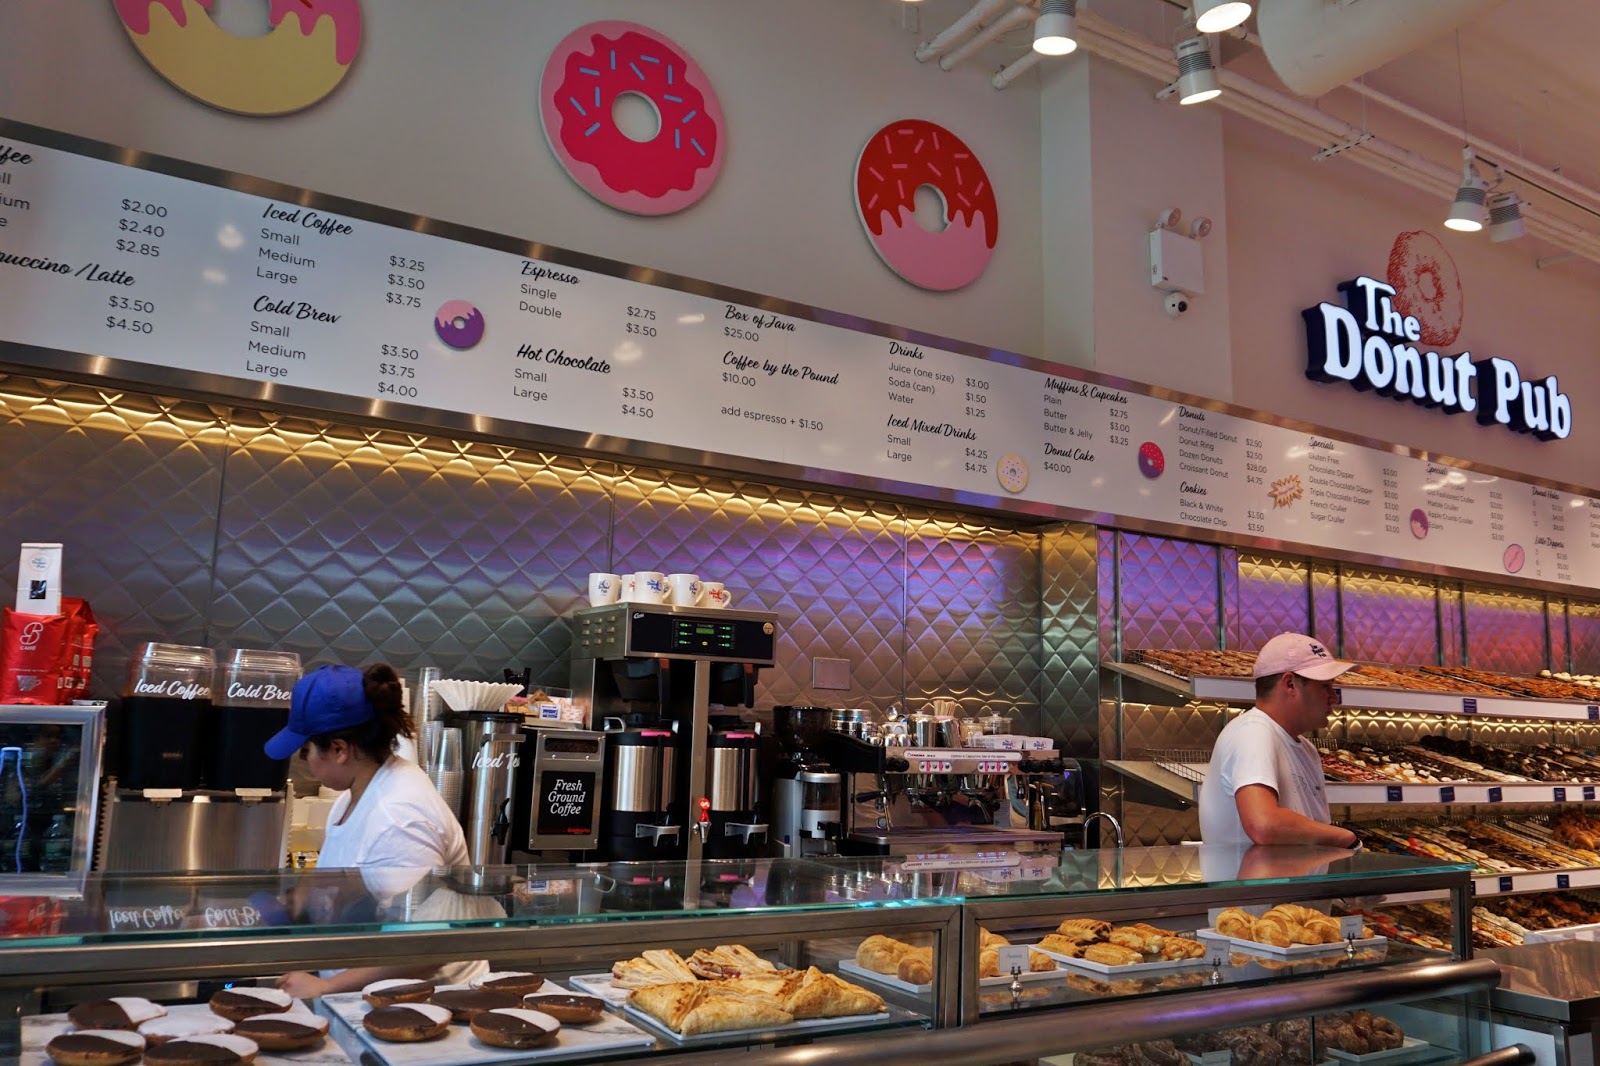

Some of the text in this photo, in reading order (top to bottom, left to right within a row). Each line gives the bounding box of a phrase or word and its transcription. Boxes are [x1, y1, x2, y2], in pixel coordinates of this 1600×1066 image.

[121, 198, 168, 218] $2.00
[118, 218, 165, 238] $2.40
[263, 203, 353, 236] Iced Coffee
[261, 228, 299, 245] Small
[116, 238, 160, 258] $2.85
[258, 247, 315, 268] Medium
[389, 255, 424, 272] $3.25
[521, 260, 580, 284] Espresso
[256, 267, 298, 284] Large
[388, 274, 424, 290] $3.50
[386, 292, 421, 308] $3.75
[521, 284, 557, 300] Single
[108, 295, 154, 314] $3.50
[254, 296, 341, 324] Cold Brew
[519, 301, 562, 318] Double
[627, 306, 656, 320] $2.75
[1356, 276, 1420, 341] The
[106, 316, 153, 334] $4.50
[725, 305, 796, 332] Box of Java
[250, 321, 290, 337] Small
[626, 323, 656, 337] $3.50
[724, 327, 759, 342] $25.00
[248, 341, 306, 360] Medium
[381, 344, 418, 360] $3.50
[517, 344, 611, 373] Hot Chocolate
[889, 342, 925, 360] Drinks
[246, 361, 288, 377] Large
[379, 363, 415, 378] $3.75
[514, 369, 547, 382] Small
[723, 351, 839, 385] Coffee by the Pound
[888, 363, 989, 390] Juice (one size) $3.00
[1320, 302, 1571, 438] Donut Pub
[722, 372, 756, 387] $10.00
[378, 382, 417, 398] $4.00
[513, 386, 548, 401] Large
[623, 388, 653, 401] $3.50
[888, 377, 986, 404] Soda (can) $1.50
[1044, 378, 1128, 405] Muffins & Cupcakes
[622, 404, 653, 418] $4.50
[888, 392, 986, 418] Water $1.25
[1044, 395, 1128, 420] Plain $2.75
[1179, 406, 1206, 422] Donuts
[721, 405, 741, 418] add
[743, 410, 787, 426] espresso
[798, 418, 823, 431] $1.50
[888, 414, 977, 441] Iced Mixed Drinks
[1044, 409, 1130, 433] Butter $3.00
[1044, 422, 1128, 446] Butter & Jelly $3.25
[1179, 423, 1262, 448] Donut/Filled Donut $2.50
[1309, 437, 1334, 450] Specials
[887, 434, 988, 460] Small $4.25
[1044, 442, 1095, 462] Donut Cake
[1179, 436, 1263, 461] Donut Ring $2.50
[887, 450, 987, 474] Large $4.75
[1044, 462, 1071, 474] $40.00
[1179, 449, 1267, 474] Dozen Donuts $28.00
[1179, 462, 1263, 485] Croissant Donut $4.75
[1180, 481, 1207, 496] Cookies
[1180, 499, 1197, 510] Black
[1206, 502, 1223, 513] White
[1248, 510, 1264, 520] $3.50
[1180, 511, 1264, 533] Chocolate Chip $3.50
[135, 679, 209, 700] Iced Coffee
[228, 682, 260, 698] Cold
[472, 752, 503, 769] Iced
[554, 779, 582, 791] Fresh
[548, 791, 586, 803] Ground
[550, 803, 581, 816] Coffee
